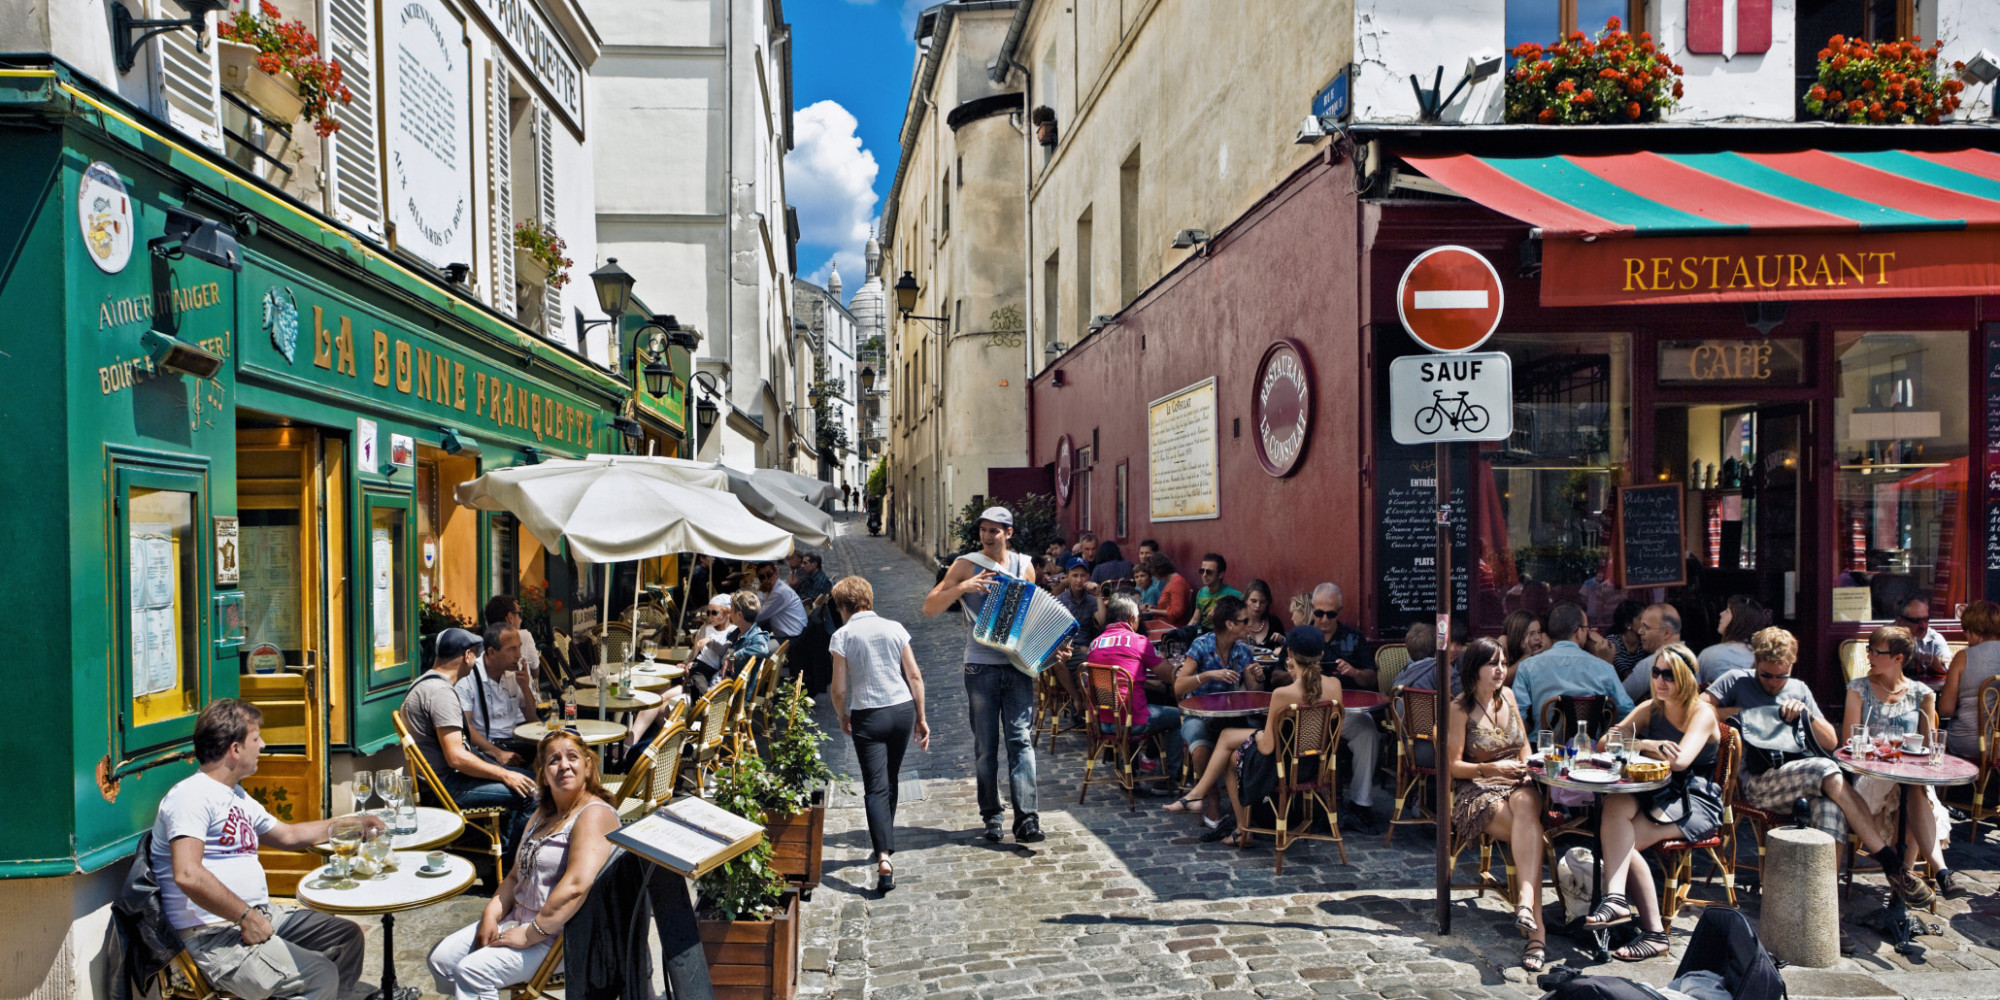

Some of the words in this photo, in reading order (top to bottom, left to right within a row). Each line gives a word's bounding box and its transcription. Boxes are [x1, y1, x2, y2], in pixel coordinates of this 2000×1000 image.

[488, 0, 577, 115] RANQUETTE
[393, 149, 407, 190] AUX
[408, 196, 443, 247] BILLARDS
[1621, 251, 1897, 292] RESTAURANT
[313, 304, 357, 378] LA
[372, 329, 467, 412] BONNE
[475, 371, 594, 450] FRANQUETTE
[1260, 355, 1308, 409] RESTAURANT
[1420, 360, 1483, 383] SAUF
[1688, 339, 1773, 381] CAFÉ
[1260, 413, 1271, 443] LE
[1269, 408, 1307, 461] CONSULAT
[1414, 557, 1435, 566] PLATS
